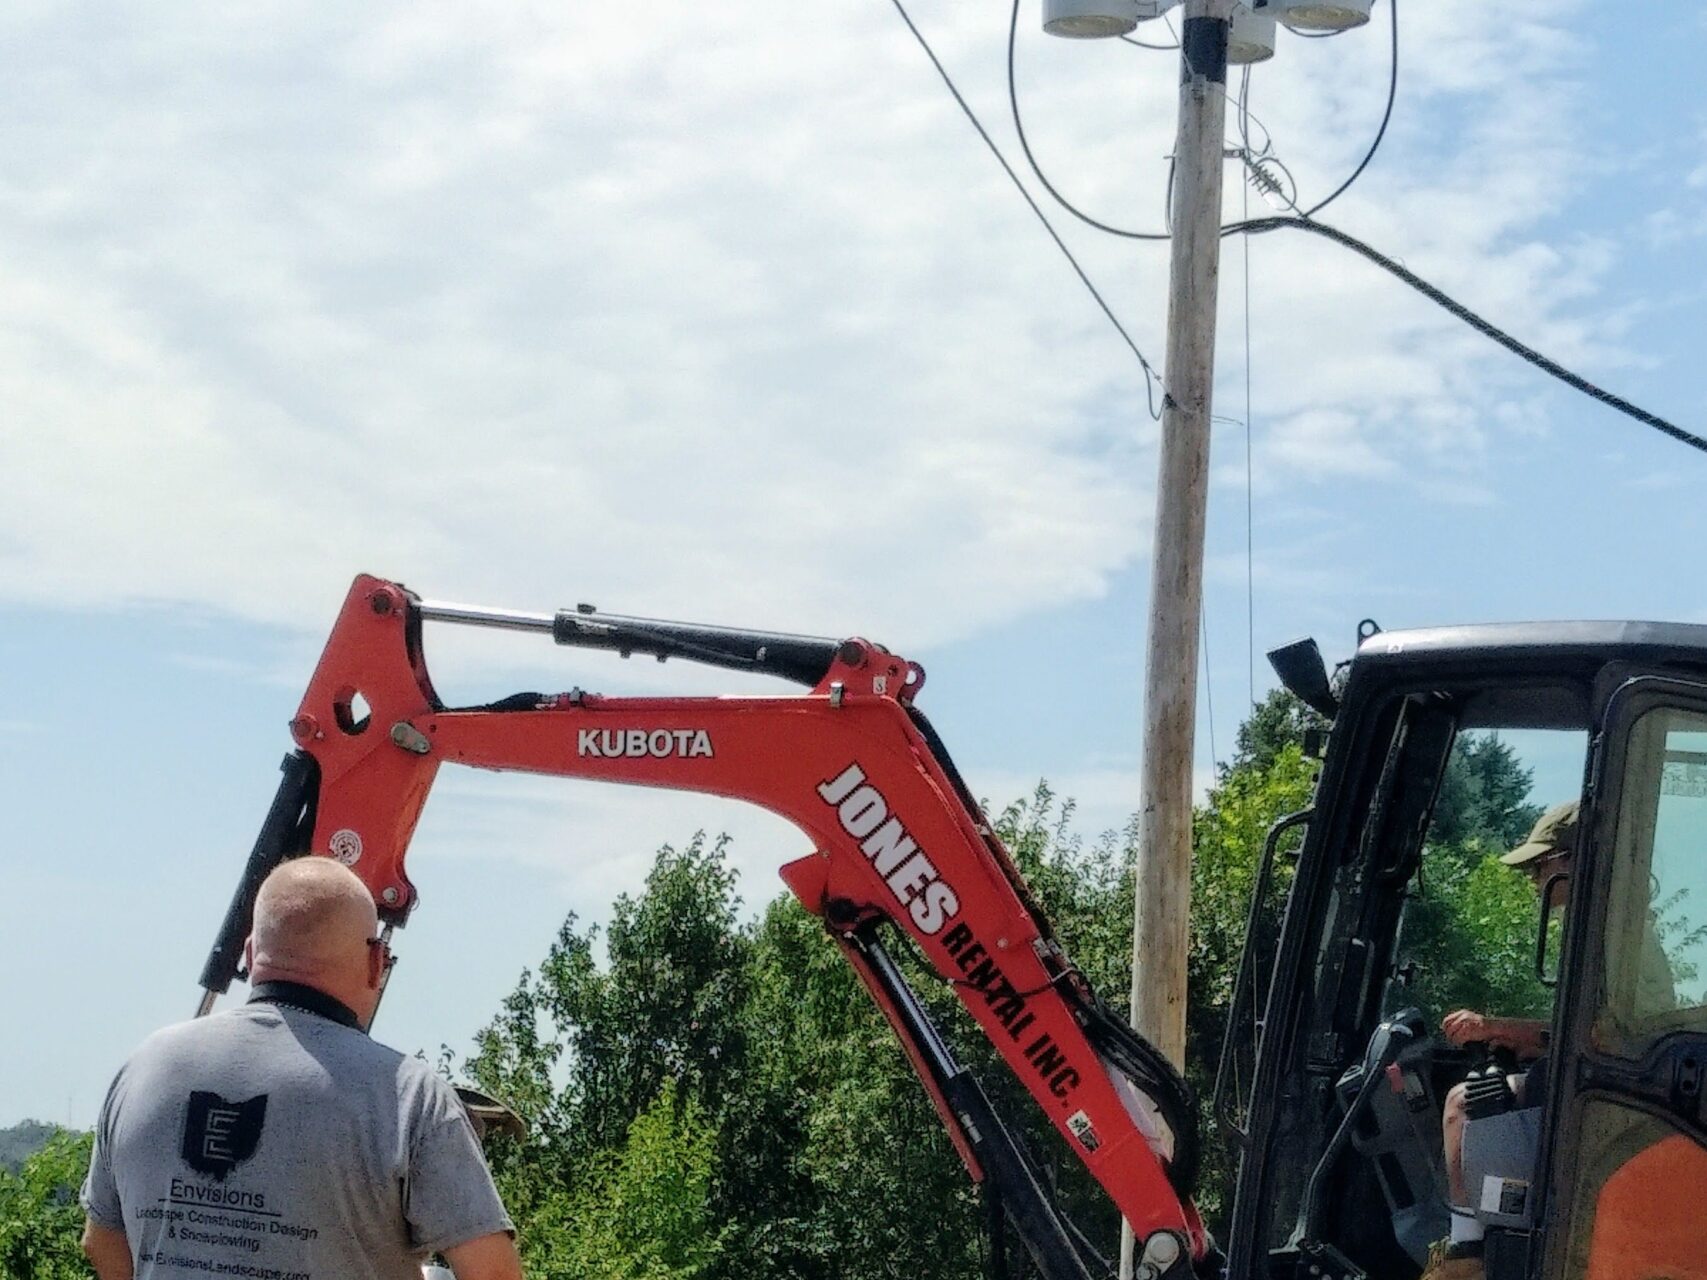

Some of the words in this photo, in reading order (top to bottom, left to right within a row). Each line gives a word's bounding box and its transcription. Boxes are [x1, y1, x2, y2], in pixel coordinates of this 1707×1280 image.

[578, 729, 714, 758] KUBOTA
[815, 761, 961, 936] JONES
[940, 921, 1036, 1043] RENTAL
[1022, 1032, 1083, 1107] INC.
[170, 1178, 265, 1208] Envisions
[168, 1226, 176, 1239] &
[180, 1227, 260, 1252] Snowplowing
[188, 1210, 266, 1232] Construction
[269, 1221, 319, 1240] Design
